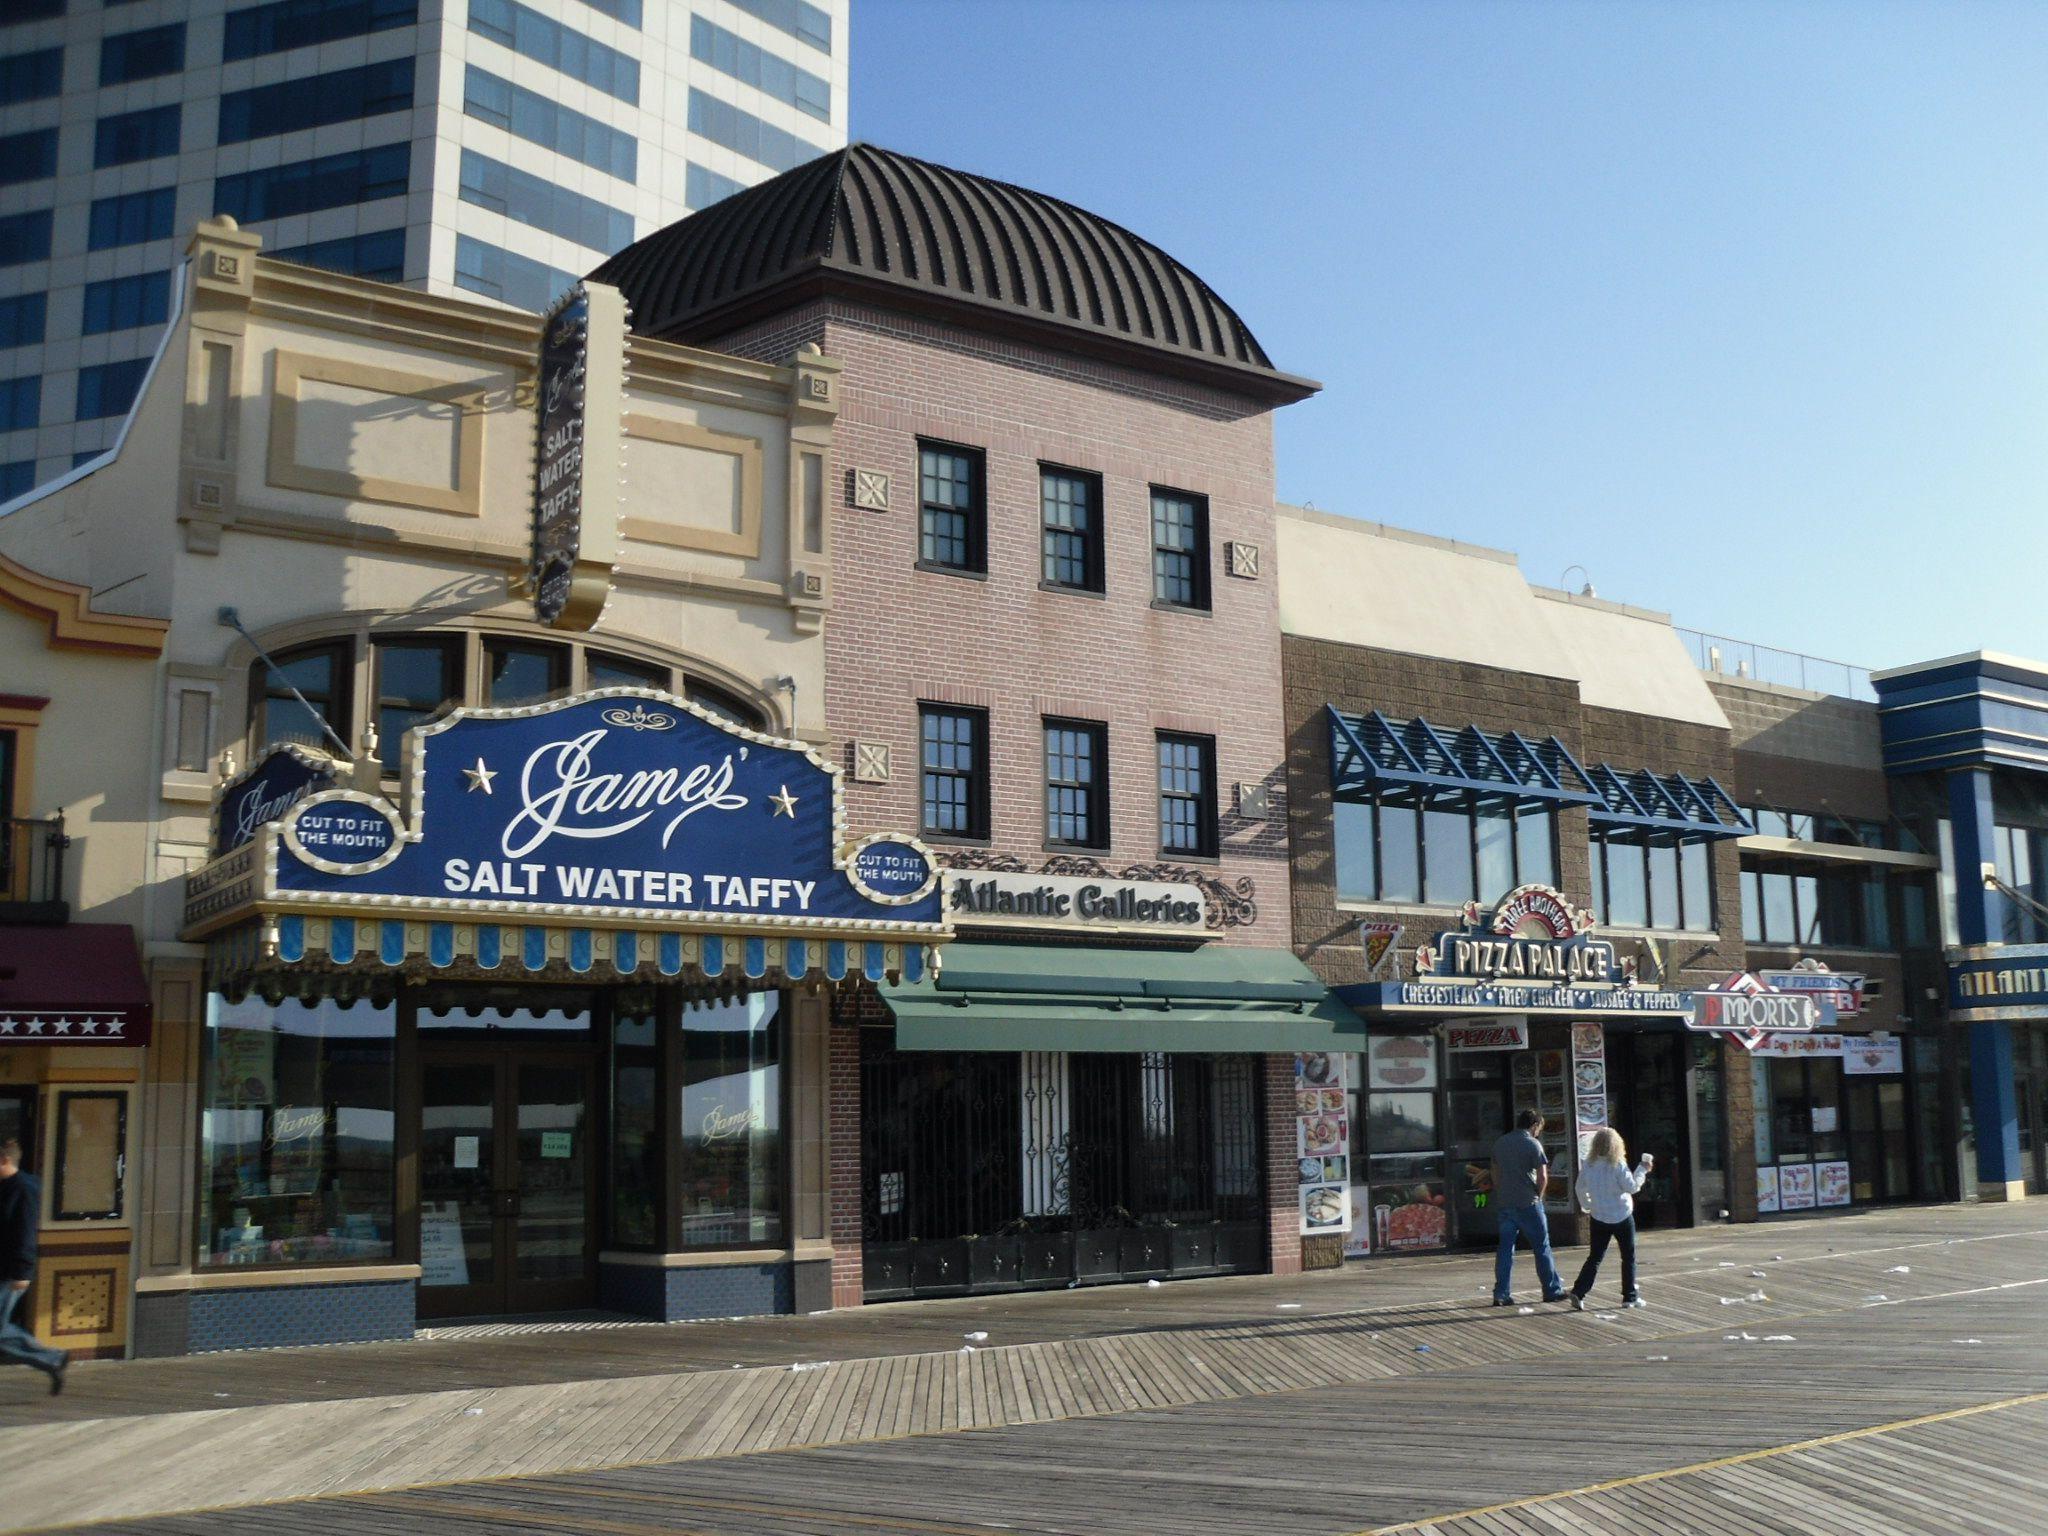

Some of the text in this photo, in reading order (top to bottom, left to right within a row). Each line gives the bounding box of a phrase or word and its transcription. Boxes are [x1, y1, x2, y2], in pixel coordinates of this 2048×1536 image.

[547, 419, 578, 457] SALT
[540, 446, 579, 491] WATER
[541, 481, 577, 523] TAFFY
[502, 729, 749, 859] James'
[298, 831, 386, 848] THE MOUTH
[301, 816, 383, 832] CUT TO FIT
[857, 868, 923, 881] THE MOUTH
[859, 855, 920, 868] CUT TO FIT
[444, 858, 816, 909] SALT WATER TAFFY
[952, 877, 1200, 924] Atlantic Galleries
[1364, 923, 1399, 932] PIZZA
[1500, 897, 1529, 932] THREE
[1455, 939, 1608, 978] PIZZA PALACE
[1402, 982, 1480, 1005] CHEESESTEAKS
[1498, 986, 1528, 1006] FRIED
[1643, 992, 1681, 1010] PEPPERS
[1447, 1025, 1523, 1048] PIZZA
